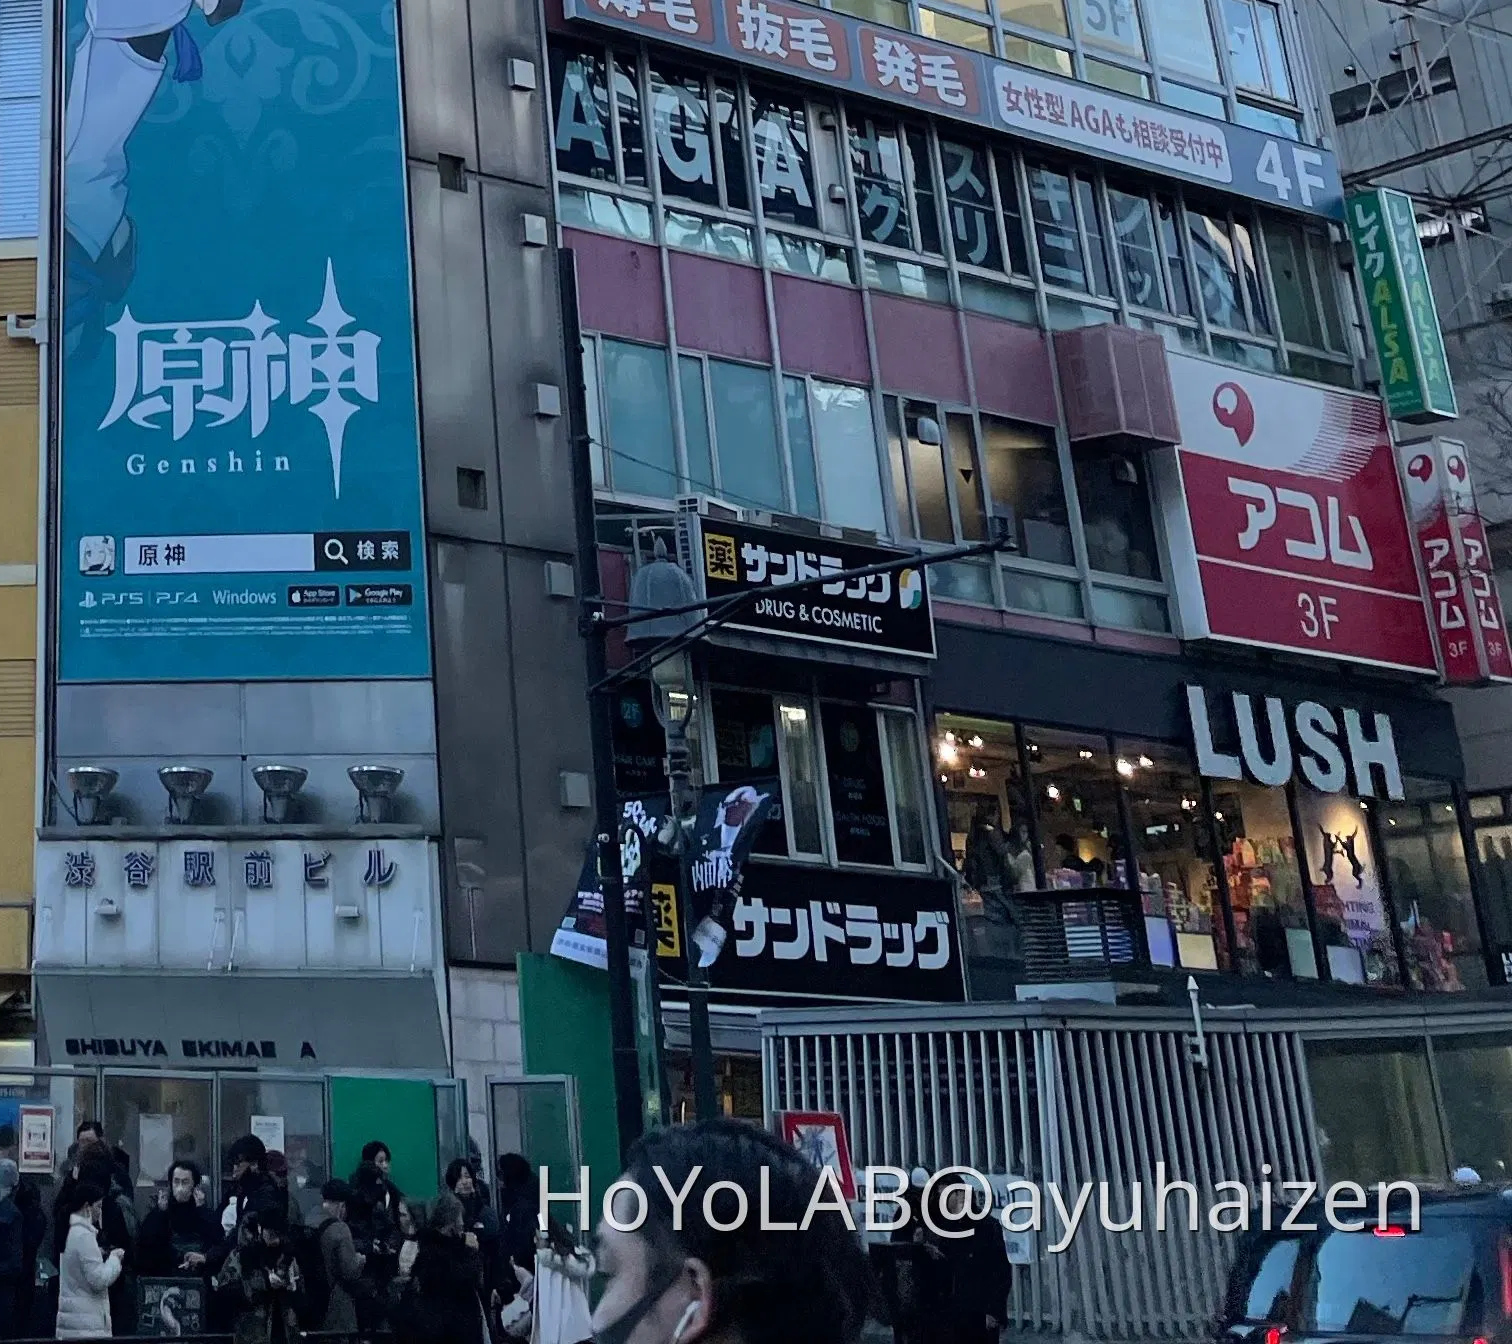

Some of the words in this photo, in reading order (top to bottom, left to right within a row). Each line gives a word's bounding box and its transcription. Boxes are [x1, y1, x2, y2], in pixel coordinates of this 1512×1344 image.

[556, 60, 813, 208] AGA
[735, 0, 839, 73] 抜毛
[871, 37, 969, 108] 発毛
[1255, 138, 1326, 207] 4F
[1354, 202, 1385, 279] レイク
[1372, 278, 1408, 384] ALSA
[1391, 200, 1418, 277] レイク
[1409, 280, 1442, 382] ALSA
[98, 256, 383, 500] 原神
[125, 449, 291, 476] Genshin
[137, 543, 186, 566] 原神
[356, 539, 400, 561] 検索
[1227, 476, 1375, 571] アコム
[101, 591, 144, 605] PS5
[156, 591, 201, 604] PS4
[212, 589, 277, 605] Windows
[706, 537, 736, 578] 薬
[741, 542, 890, 604] サンドラッグ
[1423, 538, 1466, 630] アコム
[1463, 538, 1500, 630] アコム
[755, 599, 796, 621] DRUG
[799, 607, 809, 621] &
[811, 608, 883, 634] COSMETIC
[1297, 592, 1341, 640] 3F
[1448, 640, 1468, 658] 3F
[1488, 641, 1503, 657] 3F
[1187, 684, 1405, 801] LUSH
[64, 848, 398, 888] 渋谷駅前ビル
[732, 896, 949, 970] サンドラッグ
[65, 1039, 169, 1057] SHIBUYA
[181, 1040, 277, 1059] EKIMAE
